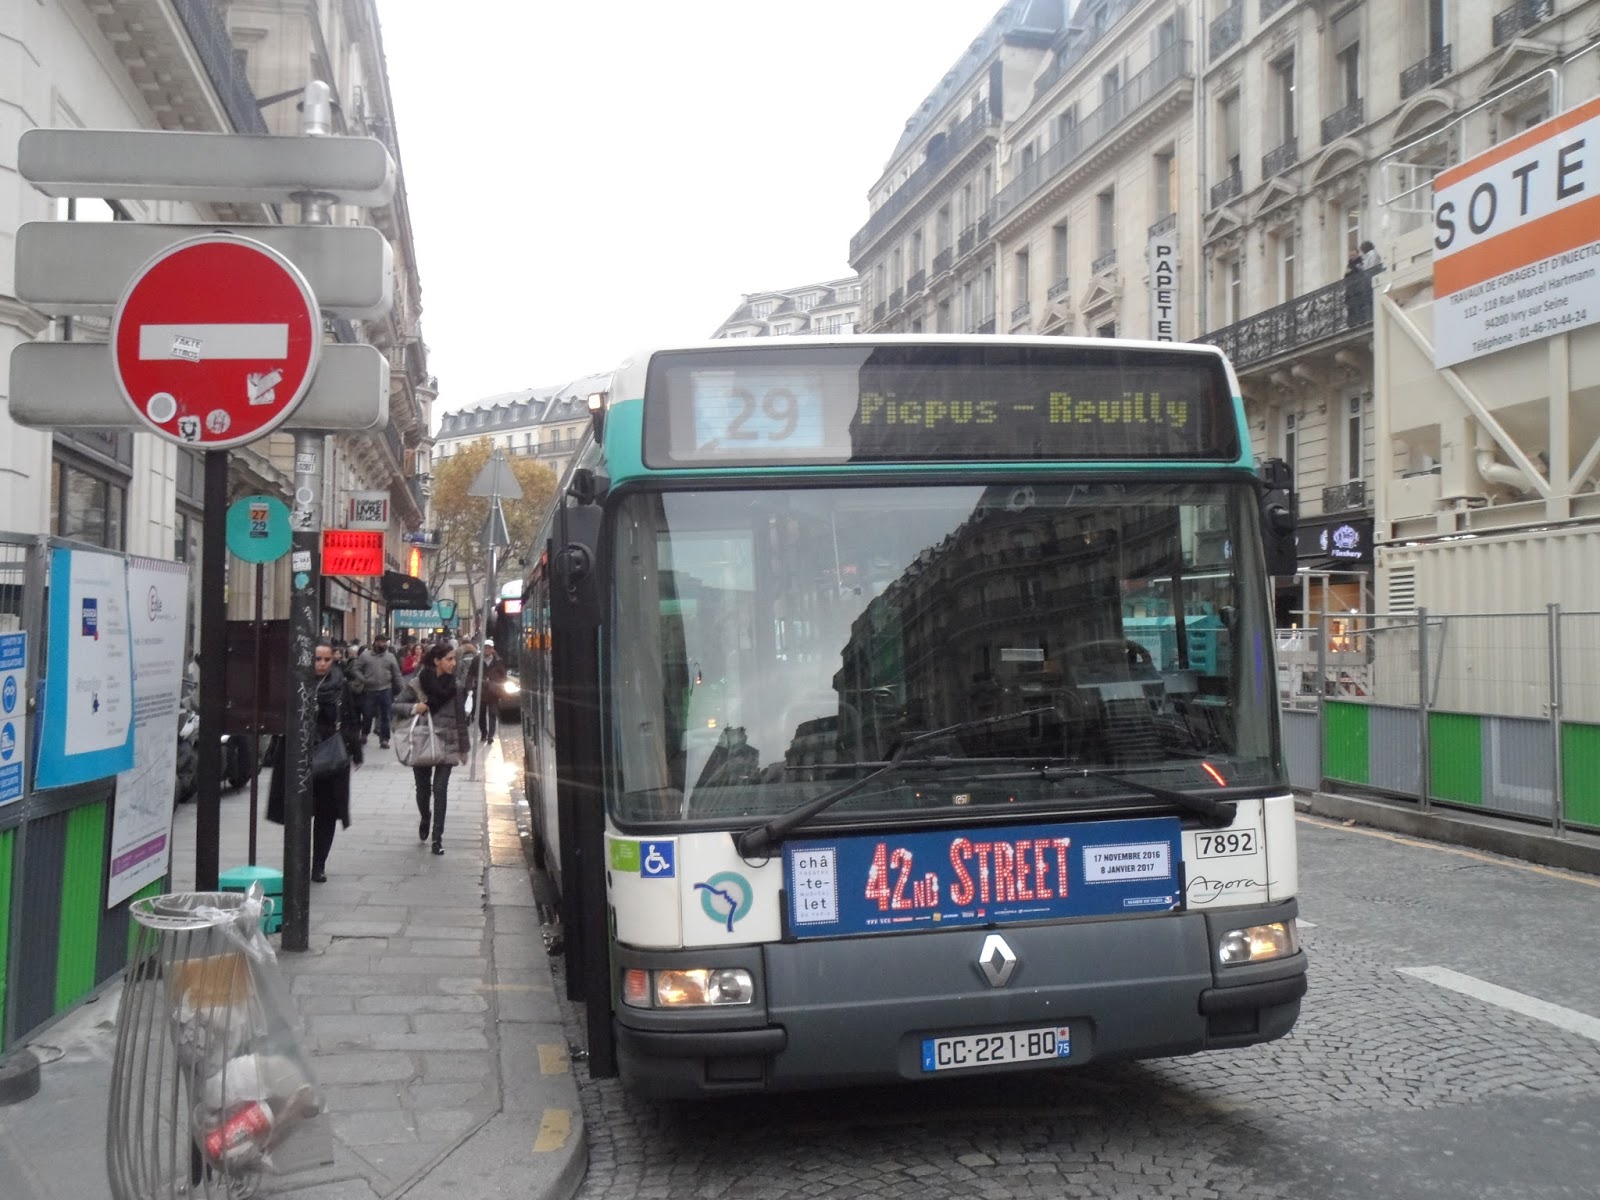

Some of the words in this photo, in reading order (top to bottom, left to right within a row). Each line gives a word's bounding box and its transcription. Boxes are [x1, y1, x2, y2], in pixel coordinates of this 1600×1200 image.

[1434, 138, 1586, 250] SOTE
[1450, 286, 1484, 305] TRAVAUX
[1486, 281, 1497, 293] DE
[1498, 265, 1537, 288] FORAGES
[1539, 261, 1549, 274] ET
[1464, 305, 1477, 319] 112
[1484, 299, 1498, 313] 118
[1500, 295, 1515, 308] Rue
[1517, 281, 1546, 300] Marcel
[1548, 268, 1595, 290] Hartmann
[1485, 313, 1509, 330] 94200
[1511, 309, 1526, 322] Ivry
[1528, 305, 1542, 317] sur
[1544, 296, 1569, 312] Seine
[1472, 334, 1513, 352] Téléphone
[1519, 309, 1587, 338] 01-46-70-44-24
[726, 388, 800, 441] 29
[861, 392, 998, 428] Picpus
[1050, 392, 1187, 427] Reuilly
[252, 510, 267, 520] 27
[356, 505, 381, 515] LIVRE
[252, 521, 266, 531] 29
[325, 533, 383, 549] CHAUSSURES
[400, 608, 440, 618] MISTRA
[1200, 833, 1253, 855] 7892
[799, 855, 828, 869] châ
[1094, 854, 1102, 863] 17
[1103, 852, 1141, 862] NOVEMBRE
[1142, 850, 1161, 860] 2016
[950, 837, 1071, 906] STREET
[1100, 866, 1106, 875] 8
[1107, 864, 1136, 874] JANVIER
[1137, 863, 1155, 872] 2017
[1186, 875, 1279, 904] Agora
[804, 898, 827, 910] let
[938, 1031, 1056, 1066] CC-221-BQ
[1059, 1043, 1070, 1054] 75
